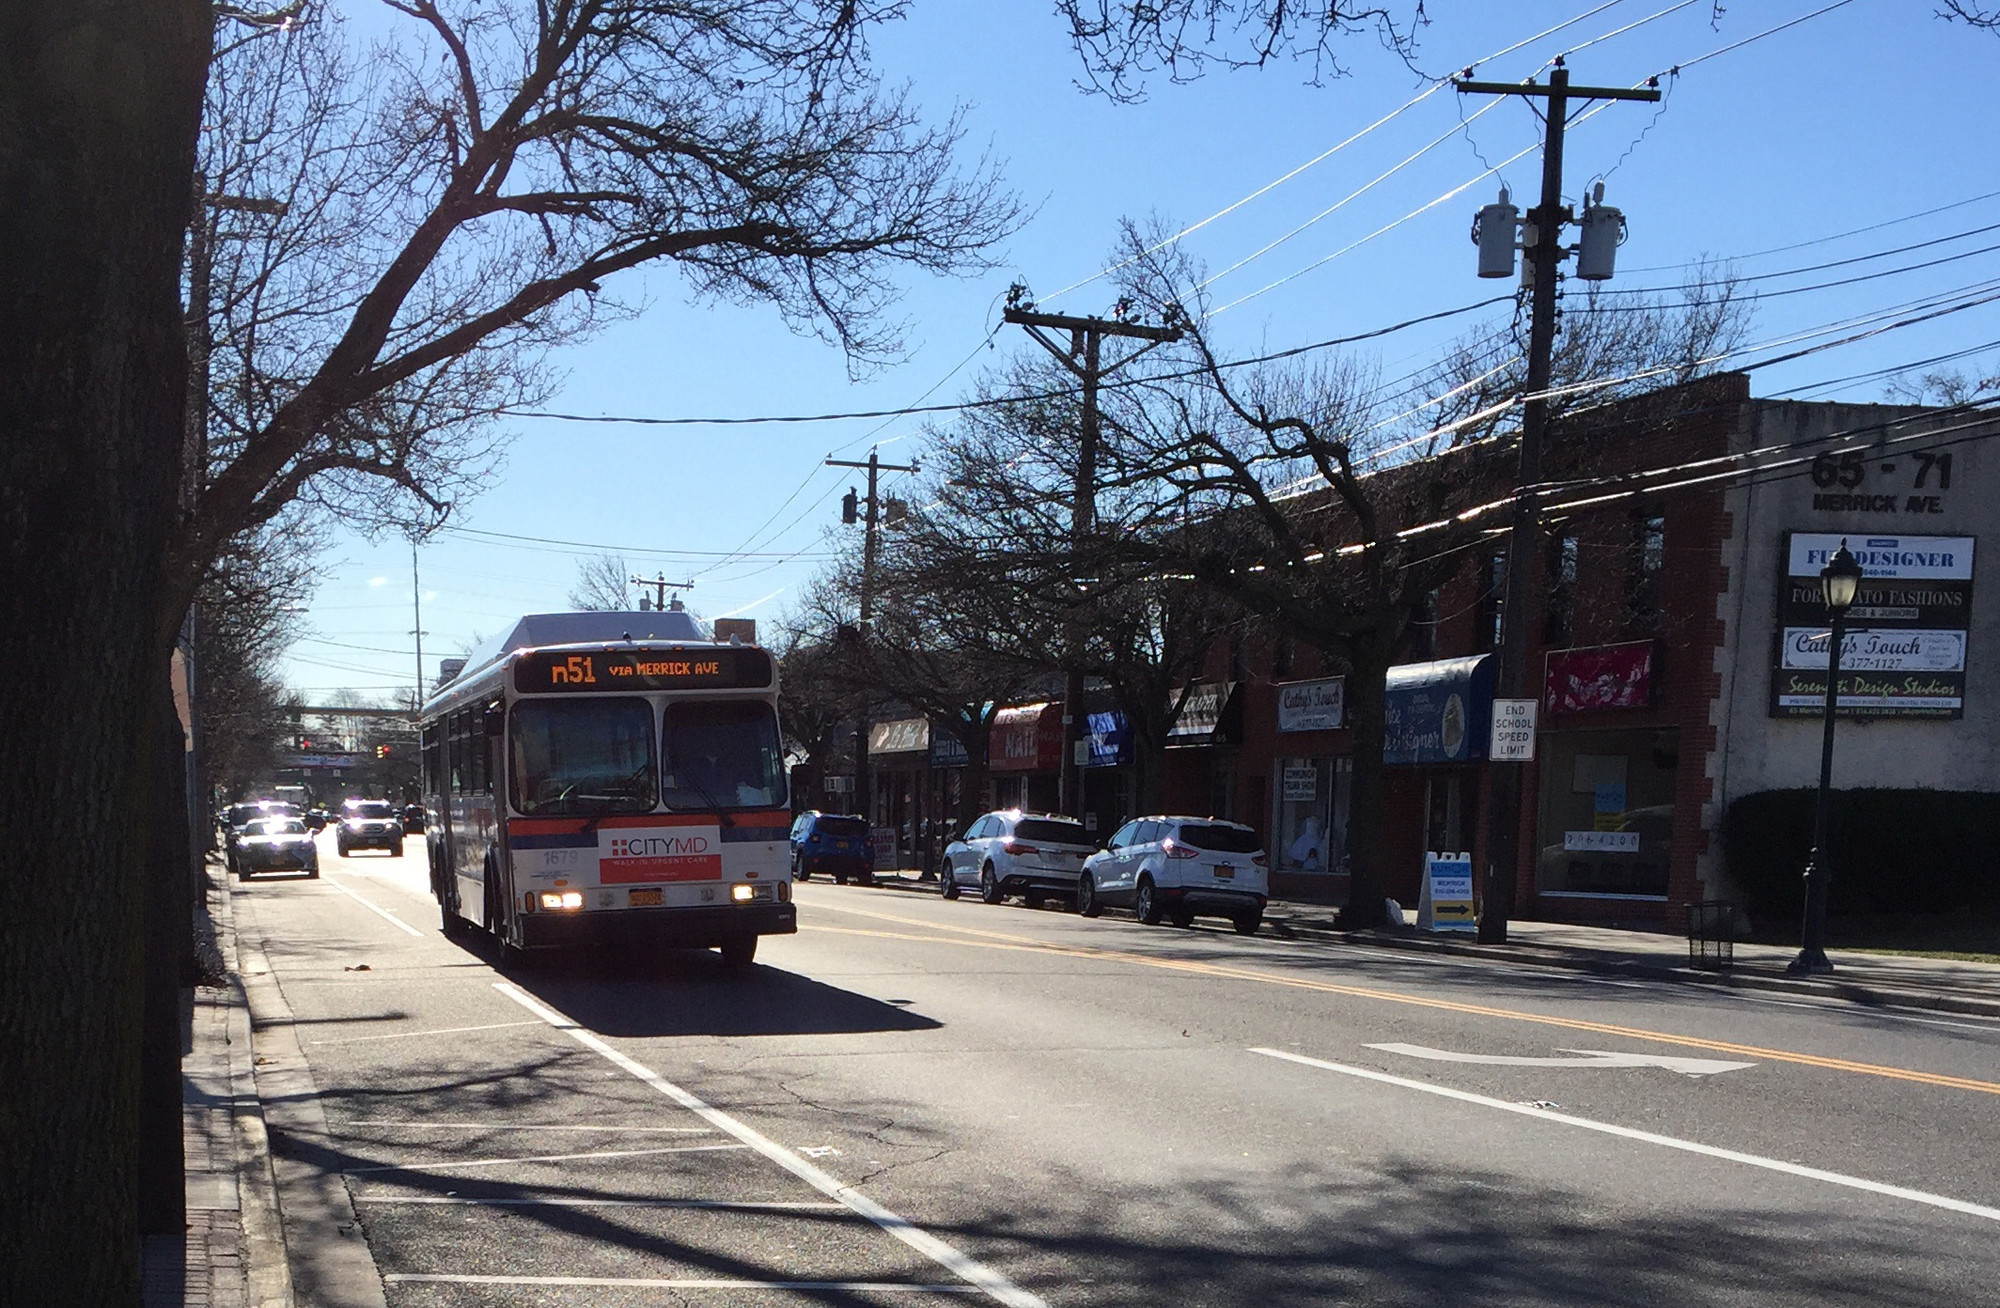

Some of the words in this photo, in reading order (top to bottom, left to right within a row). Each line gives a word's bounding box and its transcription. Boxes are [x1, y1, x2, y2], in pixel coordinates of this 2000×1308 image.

[1812, 450, 1865, 489] 65
[1913, 453, 1952, 489] 71
[1813, 494, 1898, 513] MERRICK
[1855, 551, 1954, 568] DESIGNER
[1792, 588, 1883, 604] FORATO
[1889, 591, 1963, 607] FASHIONS
[1864, 636, 1921, 655] Touch
[551, 656, 597, 684] n51
[636, 662, 690, 675] MERRICK
[695, 662, 719, 675] AVE
[1848, 658, 1902, 669] 377-1127
[1788, 675, 1849, 693] Serenti
[1854, 676, 1899, 698] Design
[1902, 676, 1956, 695] Studios
[1505, 705, 1525, 715] END
[1495, 718, 1533, 729] SCHOOL
[1498, 732, 1529, 742] SPEED
[1500, 745, 1525, 755] LIMIT
[629, 837, 708, 856] CITYMD
[544, 850, 578, 865] 1679
